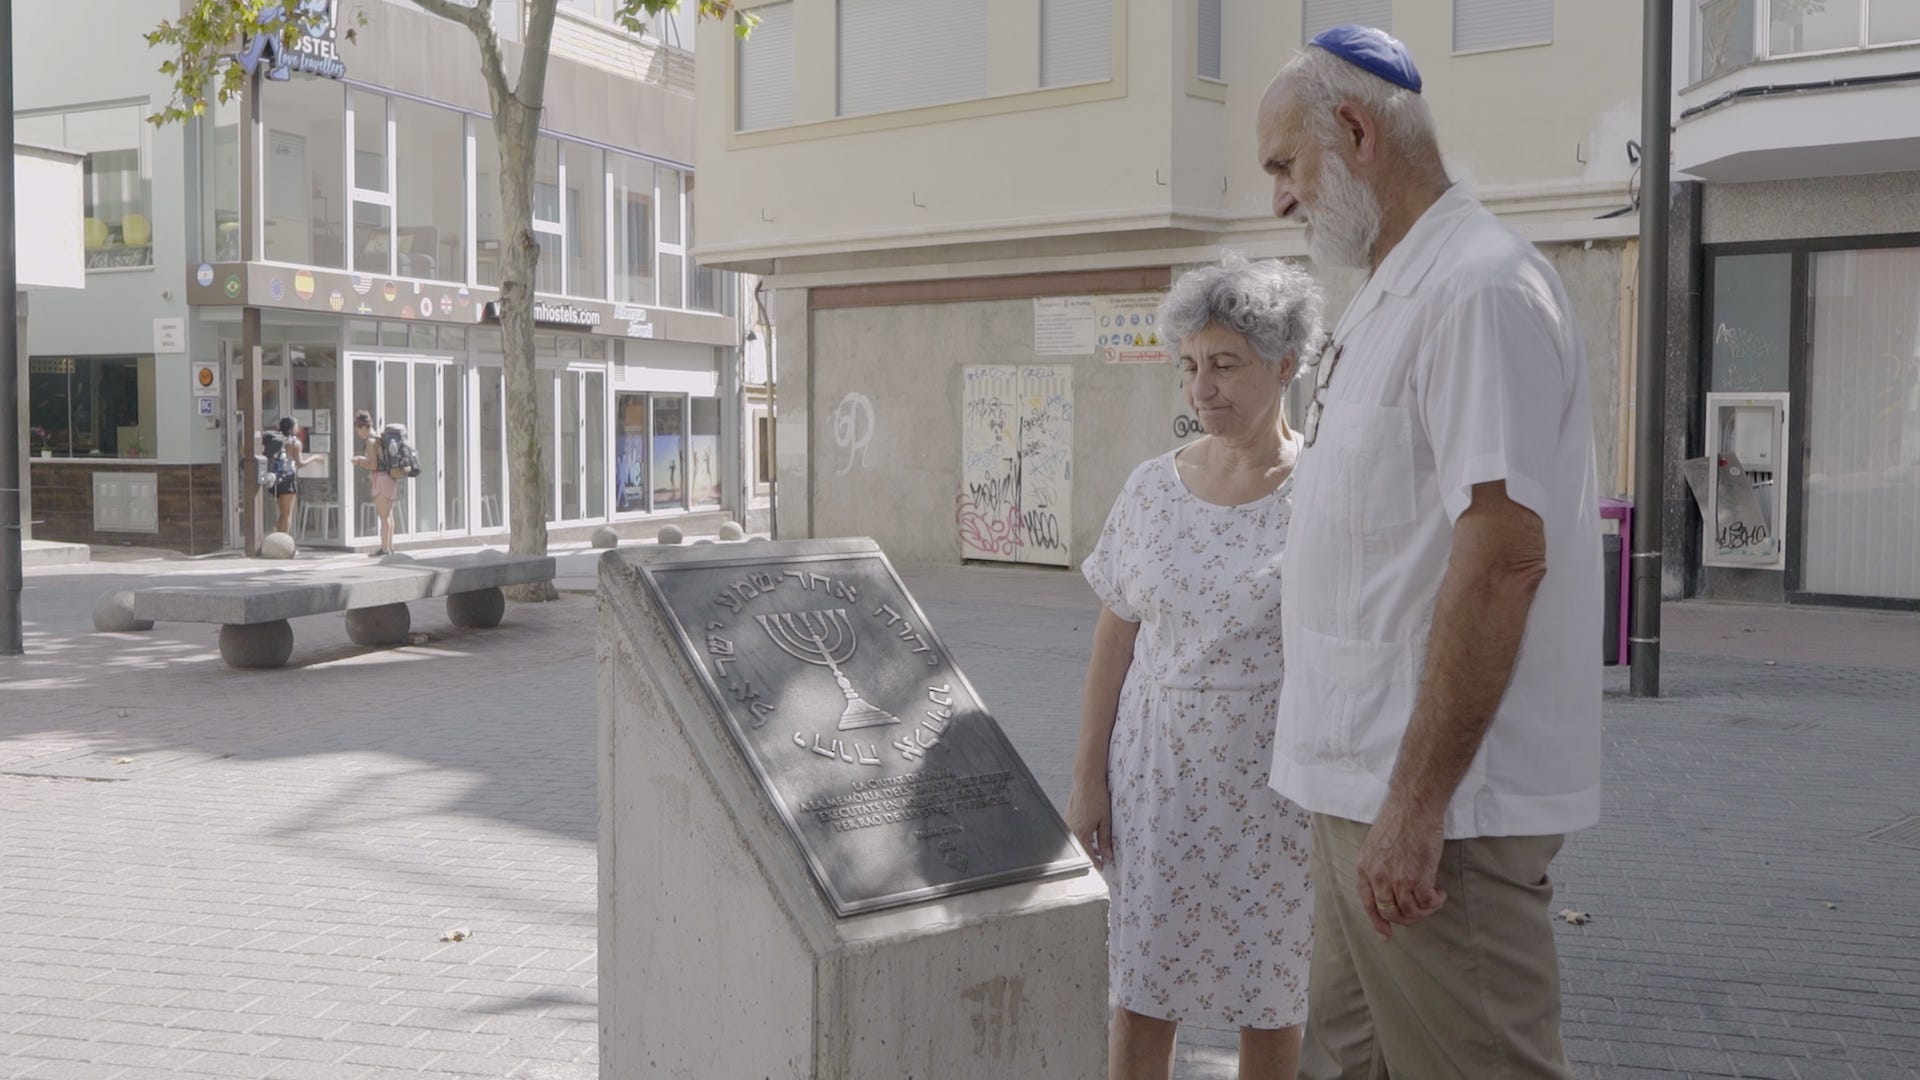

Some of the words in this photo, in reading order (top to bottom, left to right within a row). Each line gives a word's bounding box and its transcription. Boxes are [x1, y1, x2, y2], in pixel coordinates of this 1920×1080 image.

[868, 775, 904, 790] CIUTAT
[883, 785, 911, 798] DELS
[819, 801, 882, 822] EXECUTATS
[883, 799, 901, 811] EN
[834, 819, 859, 832] PER
[884, 811, 901, 824] DE
